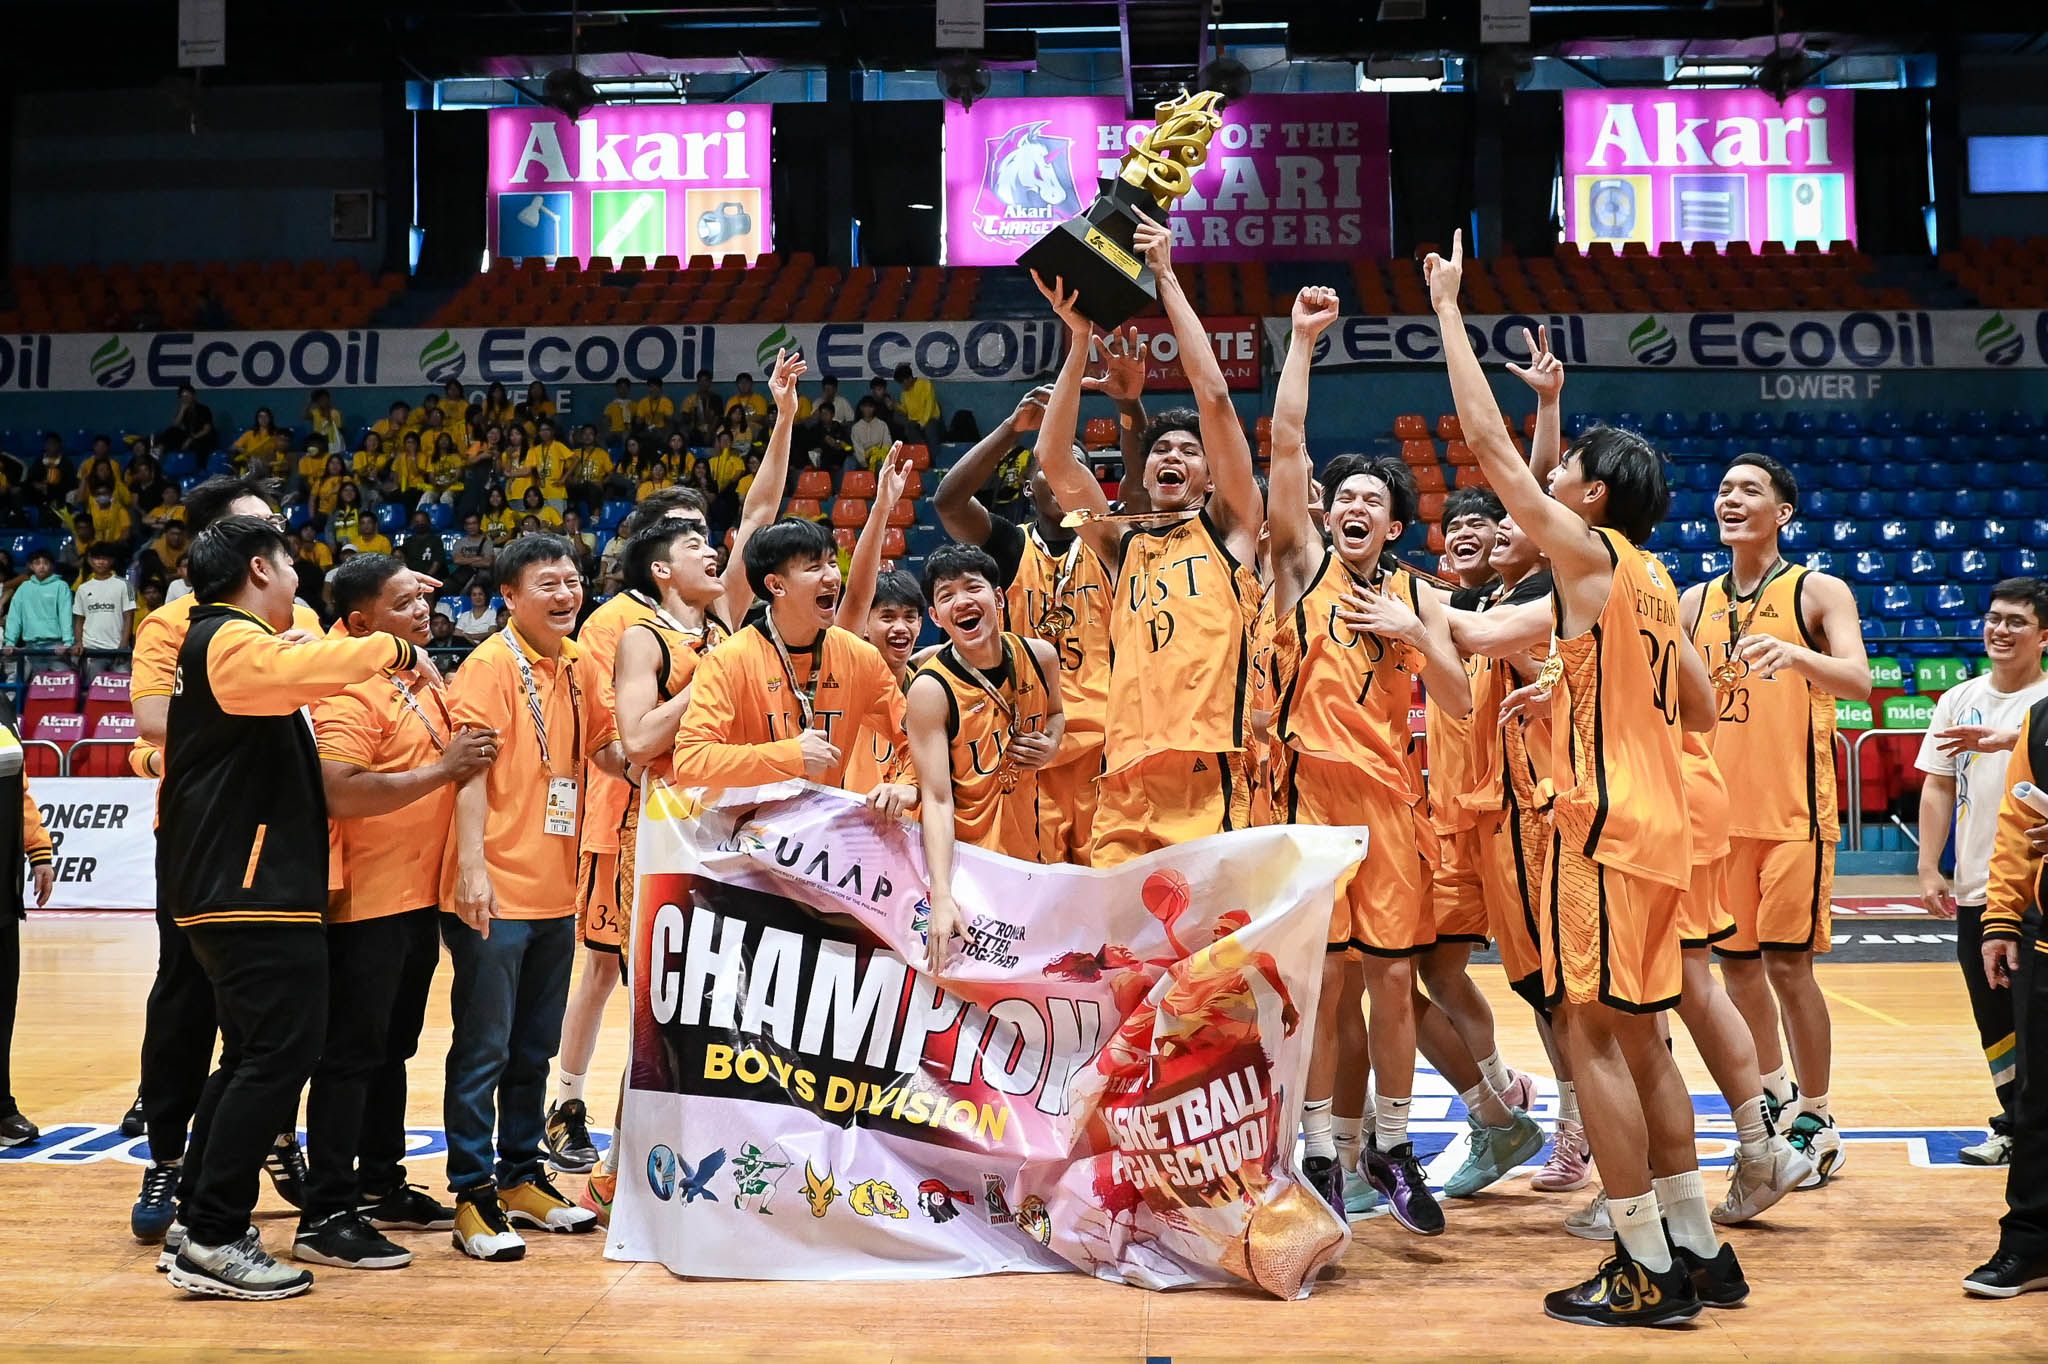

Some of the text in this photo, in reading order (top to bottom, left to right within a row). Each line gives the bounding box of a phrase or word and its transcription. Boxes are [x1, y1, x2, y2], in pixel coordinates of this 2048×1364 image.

[509, 111, 749, 183] Akari
[1220, 123, 1271, 149] OF
[1281, 122, 1359, 148] THE
[1586, 97, 1832, 166] Akari
[1004, 205, 1052, 218] Akari
[147, 331, 380, 387] EcoOil
[478, 326, 715, 382] EcoOil
[816, 321, 1056, 378] EcoOil
[1689, 312, 1934, 367] EcoOil
[1760, 375, 1880, 400] LOWER F
[1129, 553, 1209, 613] UST
[88, 602, 115, 611] adidas
[1146, 610, 1176, 653] 19
[31, 674, 75, 686] Akari
[91, 675, 130, 687] Akar
[1356, 671, 1373, 706] 1
[38, 715, 83, 728] Akari
[97, 715, 136, 727] Akar
[1719, 688, 1749, 724] 23
[650, 904, 1101, 1116] CHAMPION
[703, 1043, 1009, 1141] BOYS DIVISION
